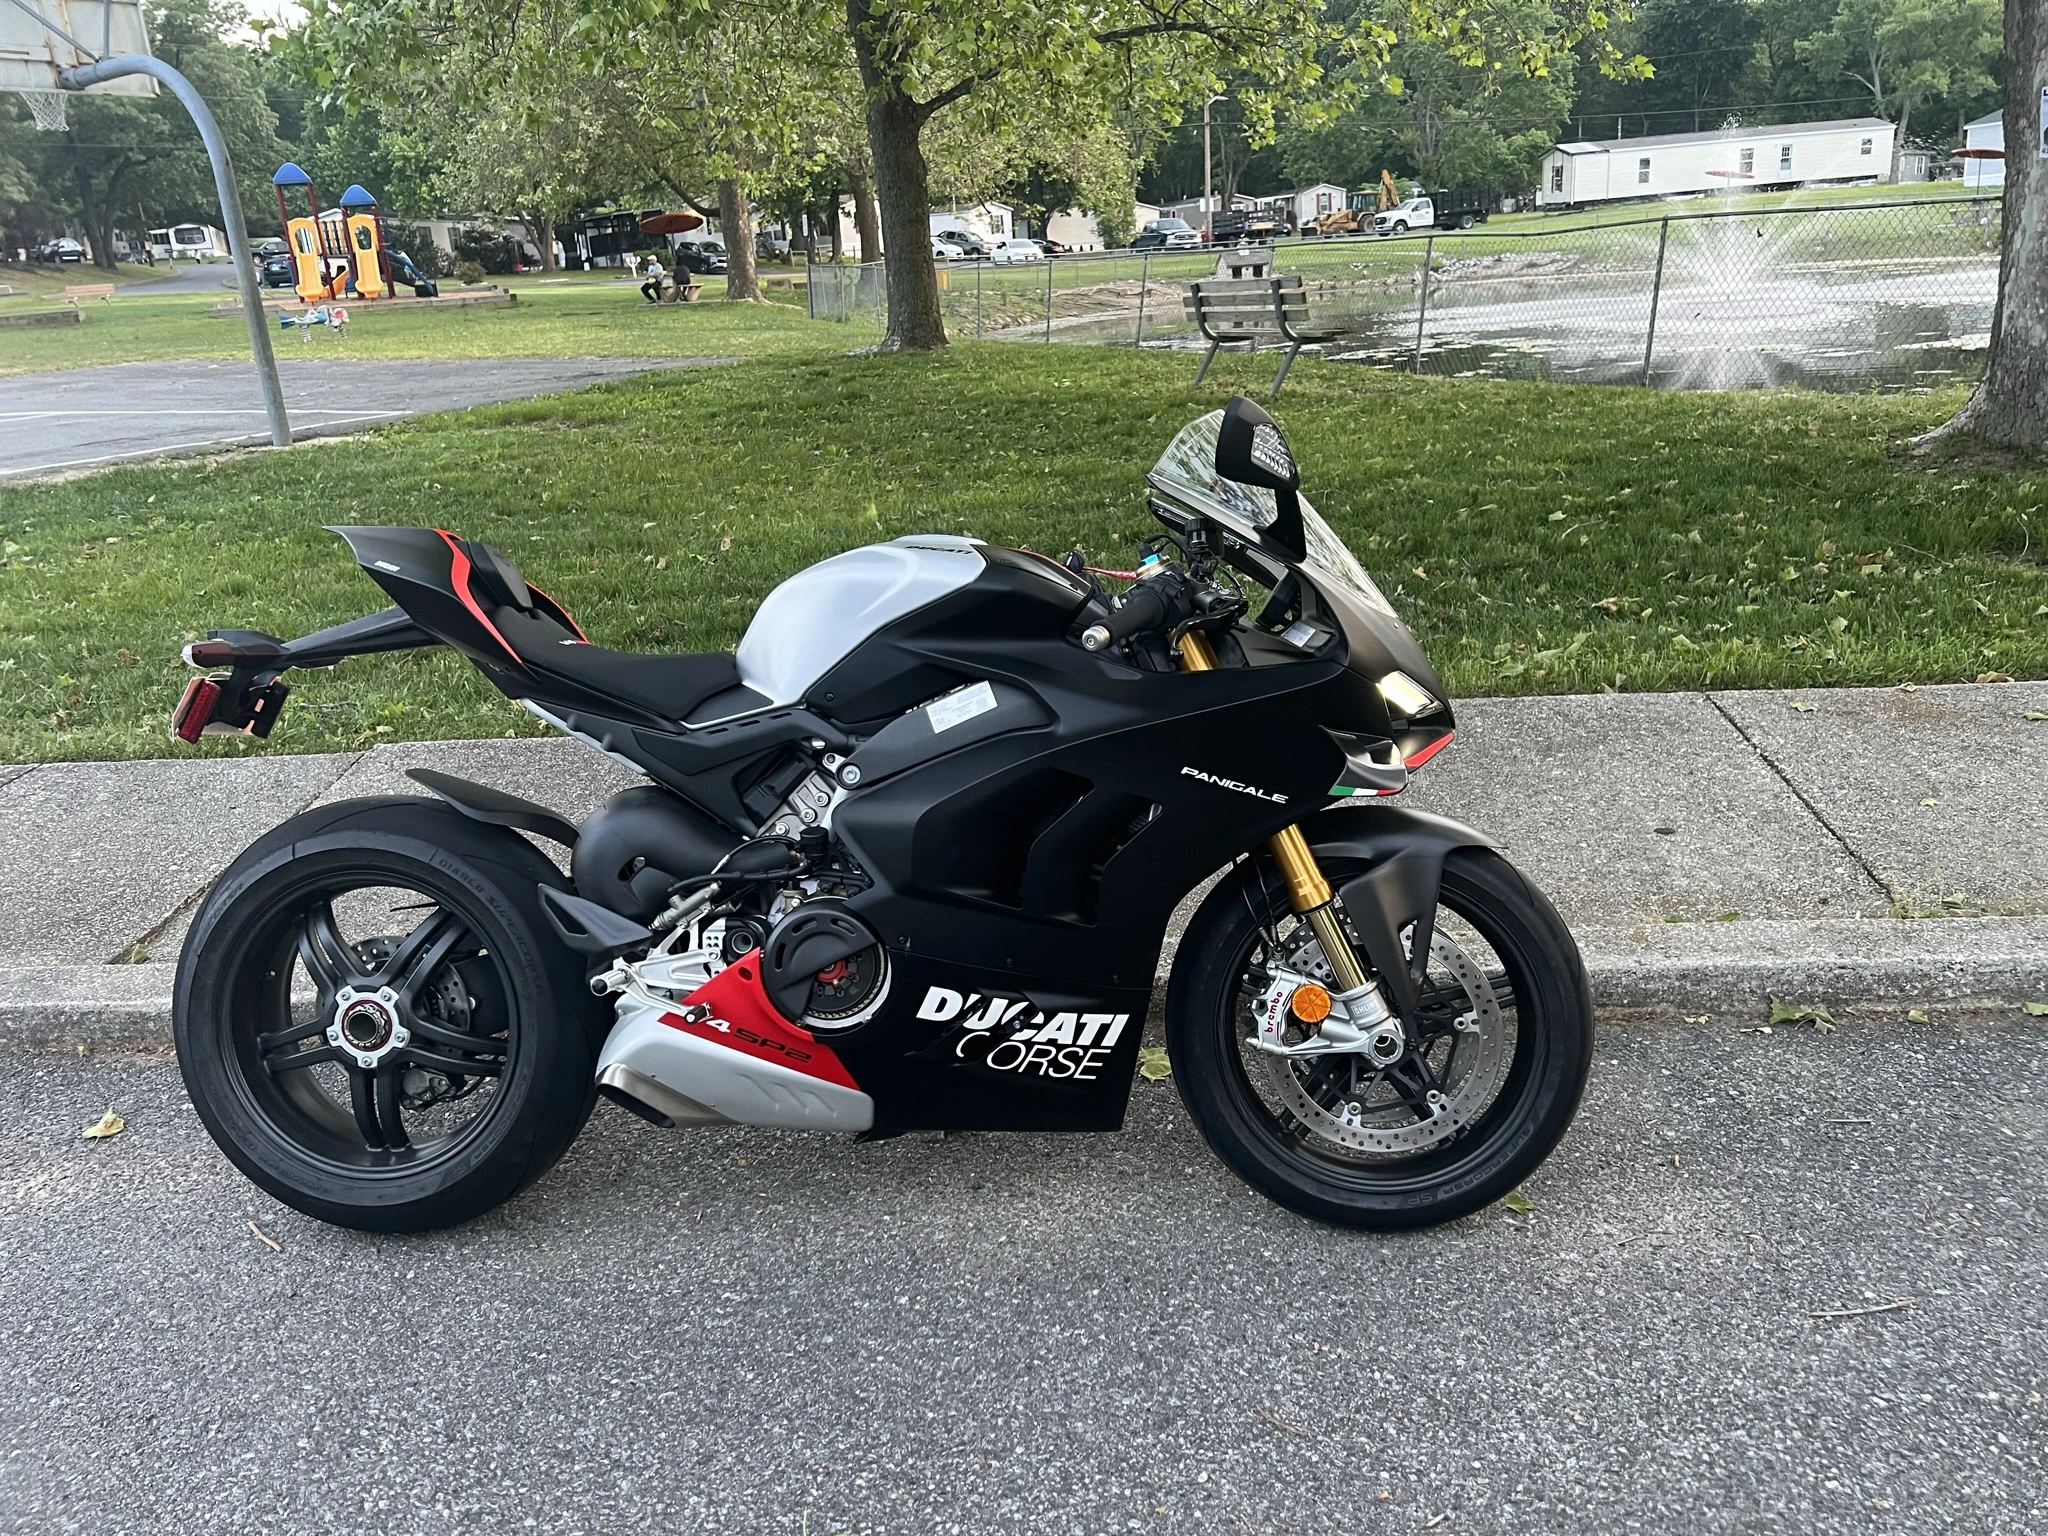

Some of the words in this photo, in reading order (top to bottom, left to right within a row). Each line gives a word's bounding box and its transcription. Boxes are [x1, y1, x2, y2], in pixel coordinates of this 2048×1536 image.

[1180, 766, 1289, 804] PANIGALE
[915, 985, 1130, 1047] DUCATI
[1263, 991, 1283, 1033] brembo
[733, 1026, 813, 1064] SP2
[955, 1031, 1112, 1080] CORSE
[1443, 1126, 1532, 1196] SUPERCORSA
[1407, 1191, 1434, 1206] SP
